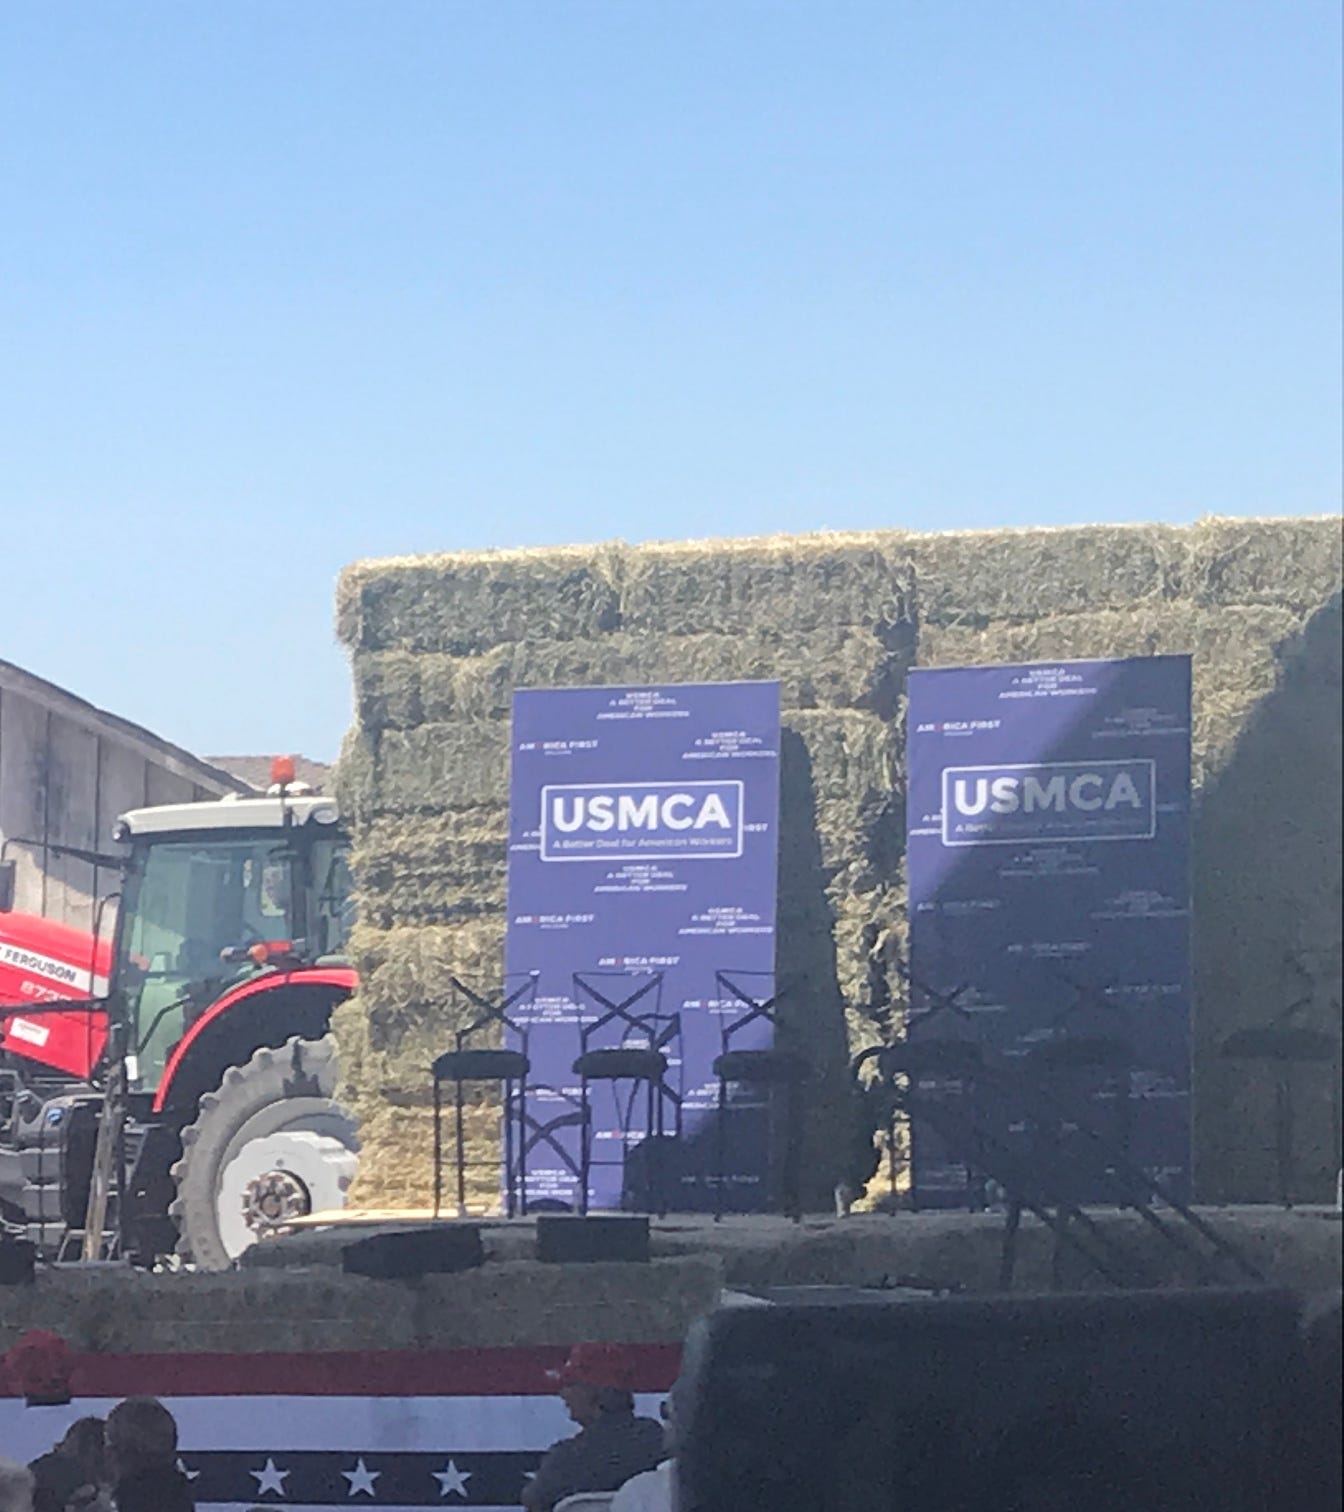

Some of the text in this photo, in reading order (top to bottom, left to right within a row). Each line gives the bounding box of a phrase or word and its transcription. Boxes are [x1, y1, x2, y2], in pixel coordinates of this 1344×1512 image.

[553, 793, 731, 832] USMCA
[954, 772, 1141, 816] USMCA
[4, 949, 77, 983] FERGUSON
